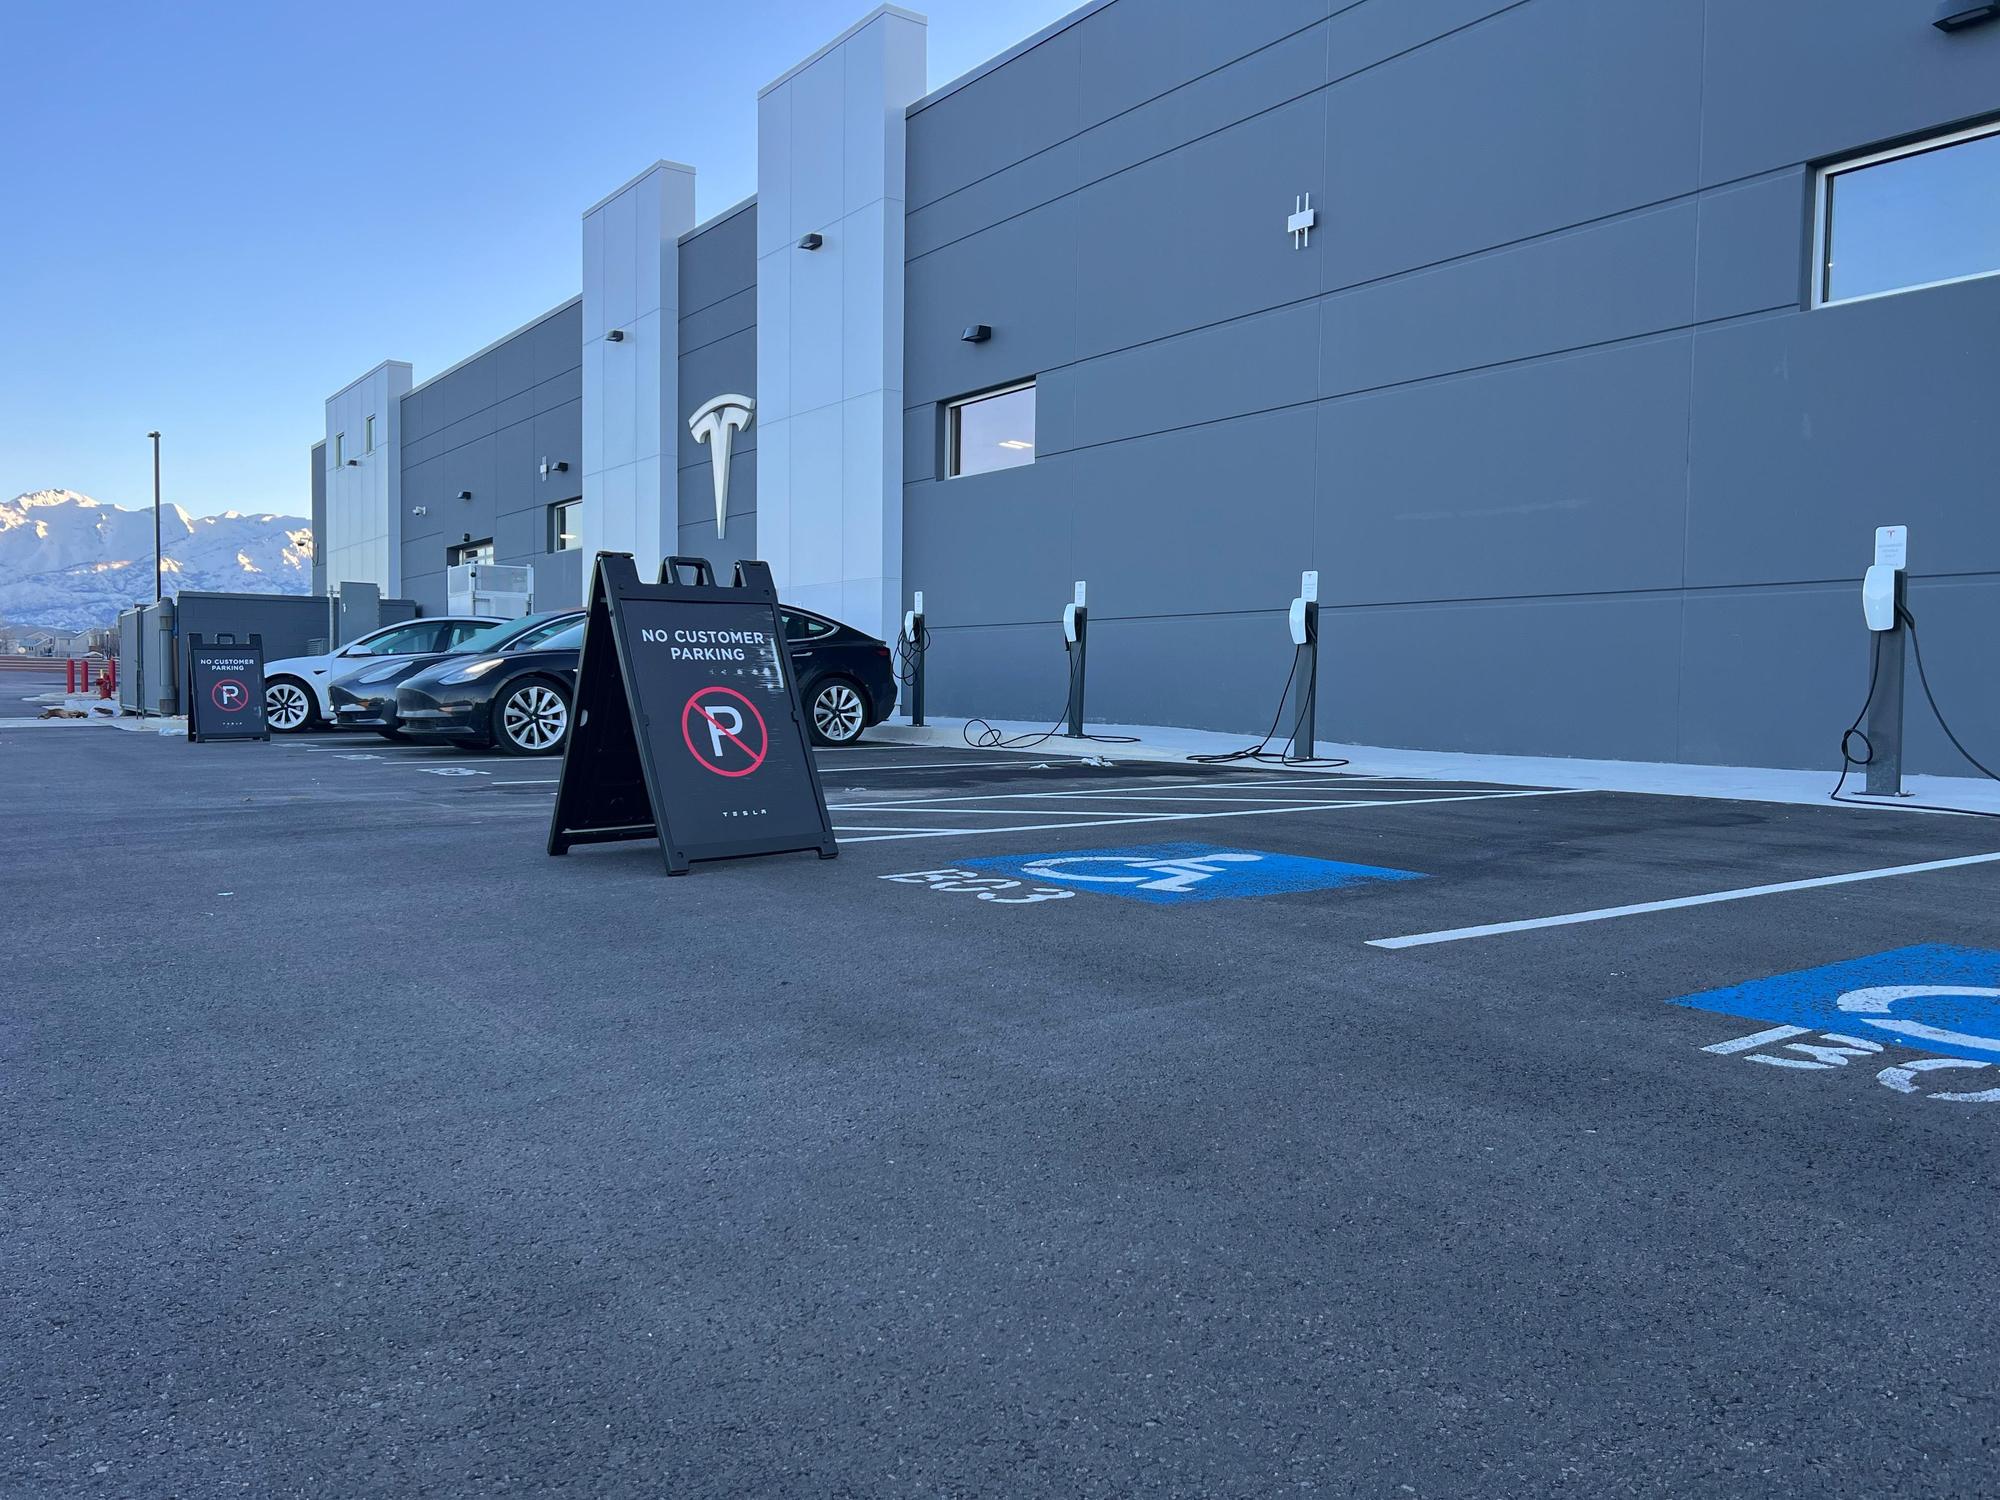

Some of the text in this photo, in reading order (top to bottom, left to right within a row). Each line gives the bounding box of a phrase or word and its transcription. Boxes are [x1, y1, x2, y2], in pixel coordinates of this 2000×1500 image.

[641, 628, 765, 644] NO CUSTOMER
[670, 647, 745, 661] PARKING
